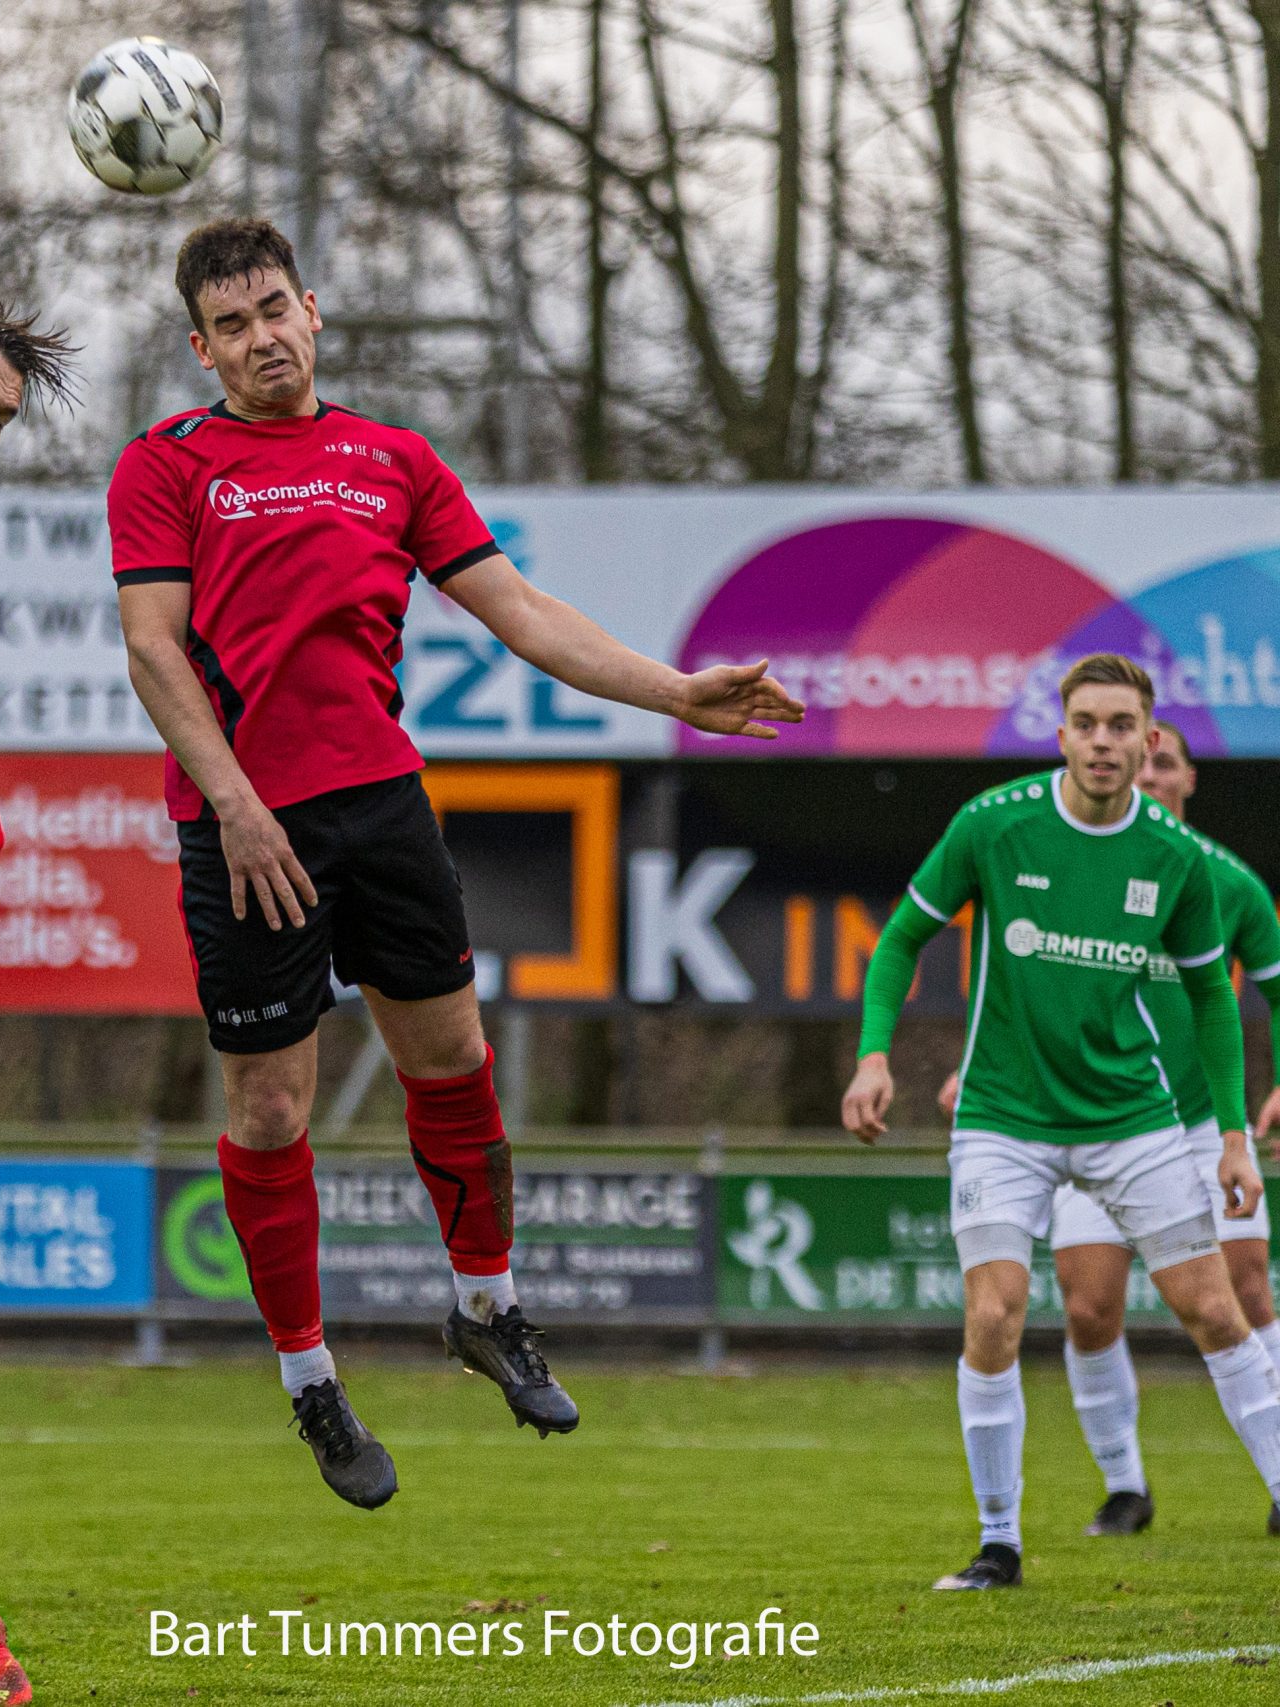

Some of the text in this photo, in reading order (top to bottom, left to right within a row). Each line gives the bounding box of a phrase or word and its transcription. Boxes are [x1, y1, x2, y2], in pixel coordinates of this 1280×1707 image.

[214, 479, 388, 514] Vencomatic Group
[263, 507, 280, 517] Agro
[280, 504, 305, 515] Supply
[1016, 872, 1051, 890] JAKO
[1005, 918, 1148, 966] HERMETICO
